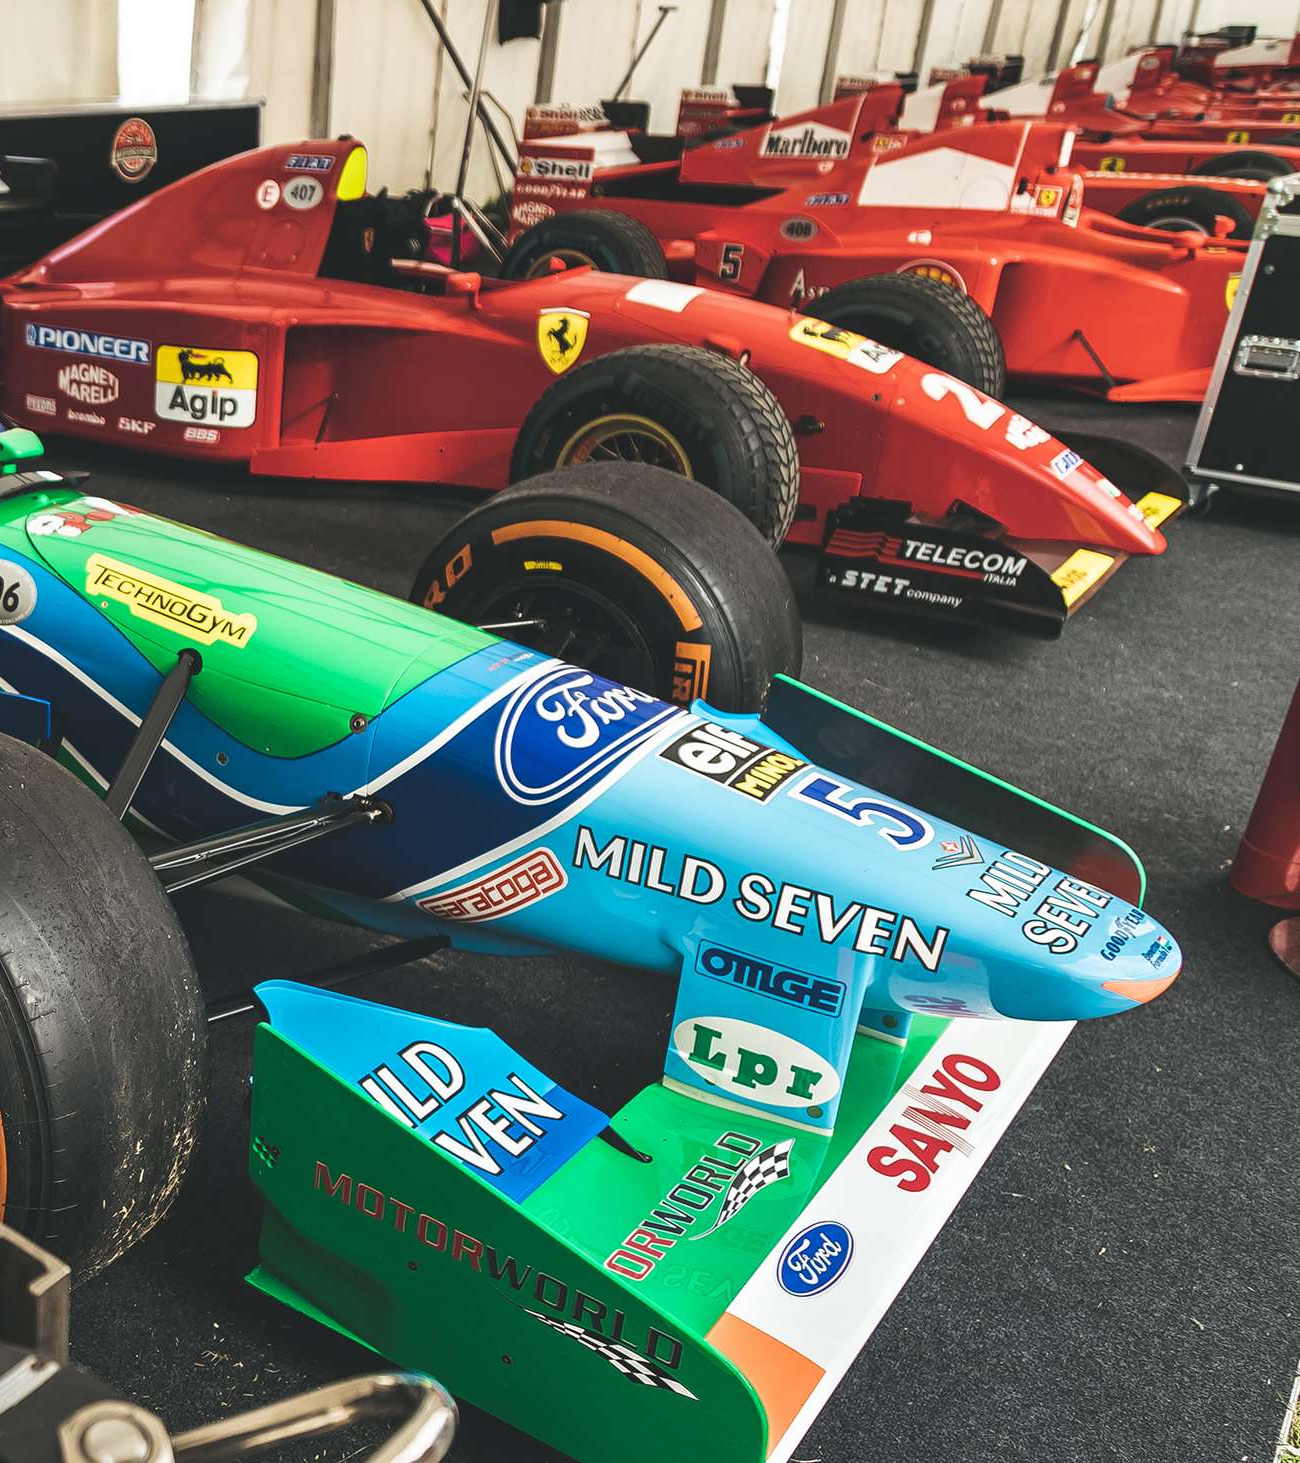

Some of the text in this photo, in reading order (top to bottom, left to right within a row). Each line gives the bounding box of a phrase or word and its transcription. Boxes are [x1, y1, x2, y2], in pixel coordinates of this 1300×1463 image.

[536, 160, 590, 179] Shell
[764, 128, 847, 158] Marlboro
[261, 185, 276, 203] E
[290, 184, 317, 202] 407
[516, 184, 587, 199] GOODYEAR
[719, 243, 745, 283] 5
[39, 326, 150, 362] PIONEER
[68, 409, 106, 425] brembo
[118, 417, 157, 434] SKF
[169, 385, 238, 421] Agip
[921, 373, 1006, 430] 2
[185, 428, 219, 443] BBS
[905, 540, 1028, 577] TELECOM
[983, 573, 1017, 587] ITALIA
[93, 563, 248, 641] TECHNOGYM
[829, 570, 964, 608] a STET company
[677, 723, 763, 776] elf
[792, 772, 935, 851] 5
[429, 860, 554, 918] saratoga
[573, 824, 950, 974] MILD SEVEN
[966, 850, 1053, 918] MILD
[1021, 876, 1114, 955] SEVE
[1100, 908, 1146, 962] GOODYEAR
[358, 1040, 466, 1128] ILD
[688, 1024, 823, 1099] Lpr
[430, 1072, 567, 1177] VEN
[866, 1053, 1001, 1193] SANYO
[602, 1129, 763, 1282] ORWORLD
[314, 1160, 684, 1370] MOTORWORLD
[783, 1230, 844, 1290] Ford
